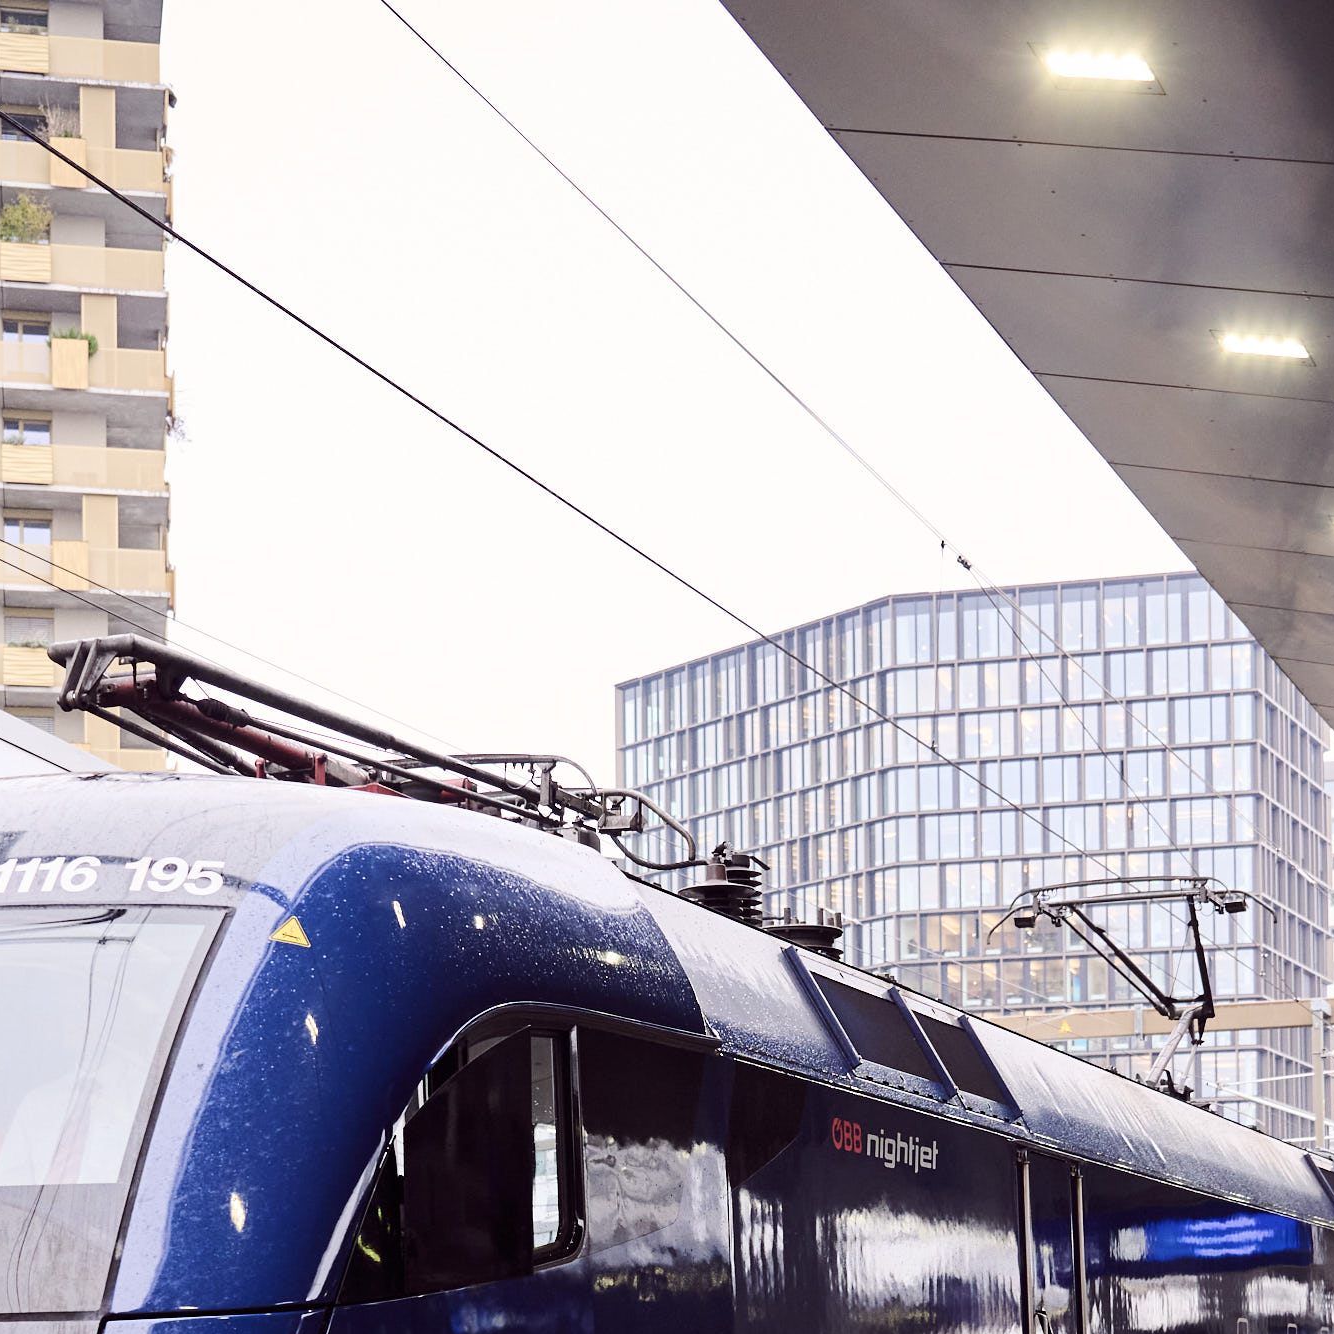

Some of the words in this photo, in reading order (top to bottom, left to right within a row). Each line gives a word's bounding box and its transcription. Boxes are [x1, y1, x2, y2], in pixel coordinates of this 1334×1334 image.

[124, 856, 226, 896] 195
[832, 1117, 863, 1154] ÖBB
[866, 1129, 939, 1174] nightjet
